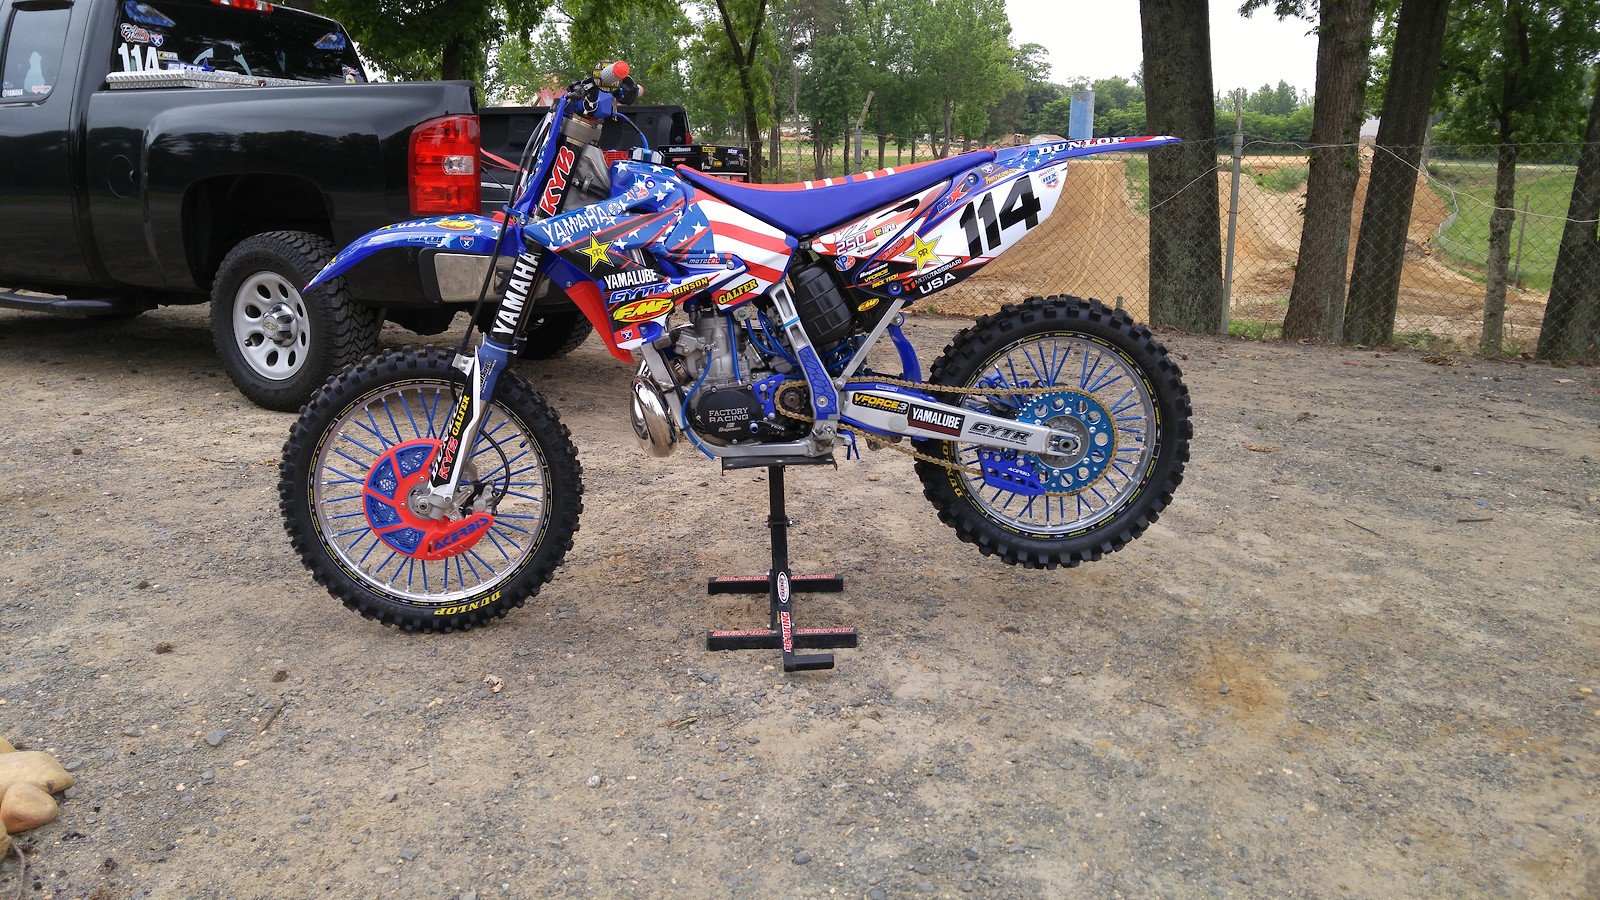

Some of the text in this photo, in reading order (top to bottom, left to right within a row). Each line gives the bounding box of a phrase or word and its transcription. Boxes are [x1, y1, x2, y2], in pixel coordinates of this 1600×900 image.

[1037, 136, 1128, 155] DUNLOP
[539, 146, 575, 217] KYB
[541, 204, 609, 243] YAMAHA
[959, 174, 1042, 260] 114
[836, 232, 867, 256] 250
[604, 268, 658, 290] YAMALUBE
[673, 277, 709, 296] HINSON
[919, 272, 956, 295] USA
[492, 252, 541, 334] YAMAHA
[609, 281, 670, 303] GYTR
[718, 279, 758, 305] GALFER
[613, 298, 674, 321] FMF
[708, 407, 749, 417] FACTORY
[854, 393, 908, 411] VFORCE3
[451, 394, 470, 436] GALFER
[709, 413, 749, 423] RACING
[911, 406, 962, 430] YAMALUBE
[969, 421, 1033, 442] GYTR
[438, 436, 458, 480] KYB
[433, 516, 489, 551] ACERBIS
[434, 591, 502, 616] DUNLOP
